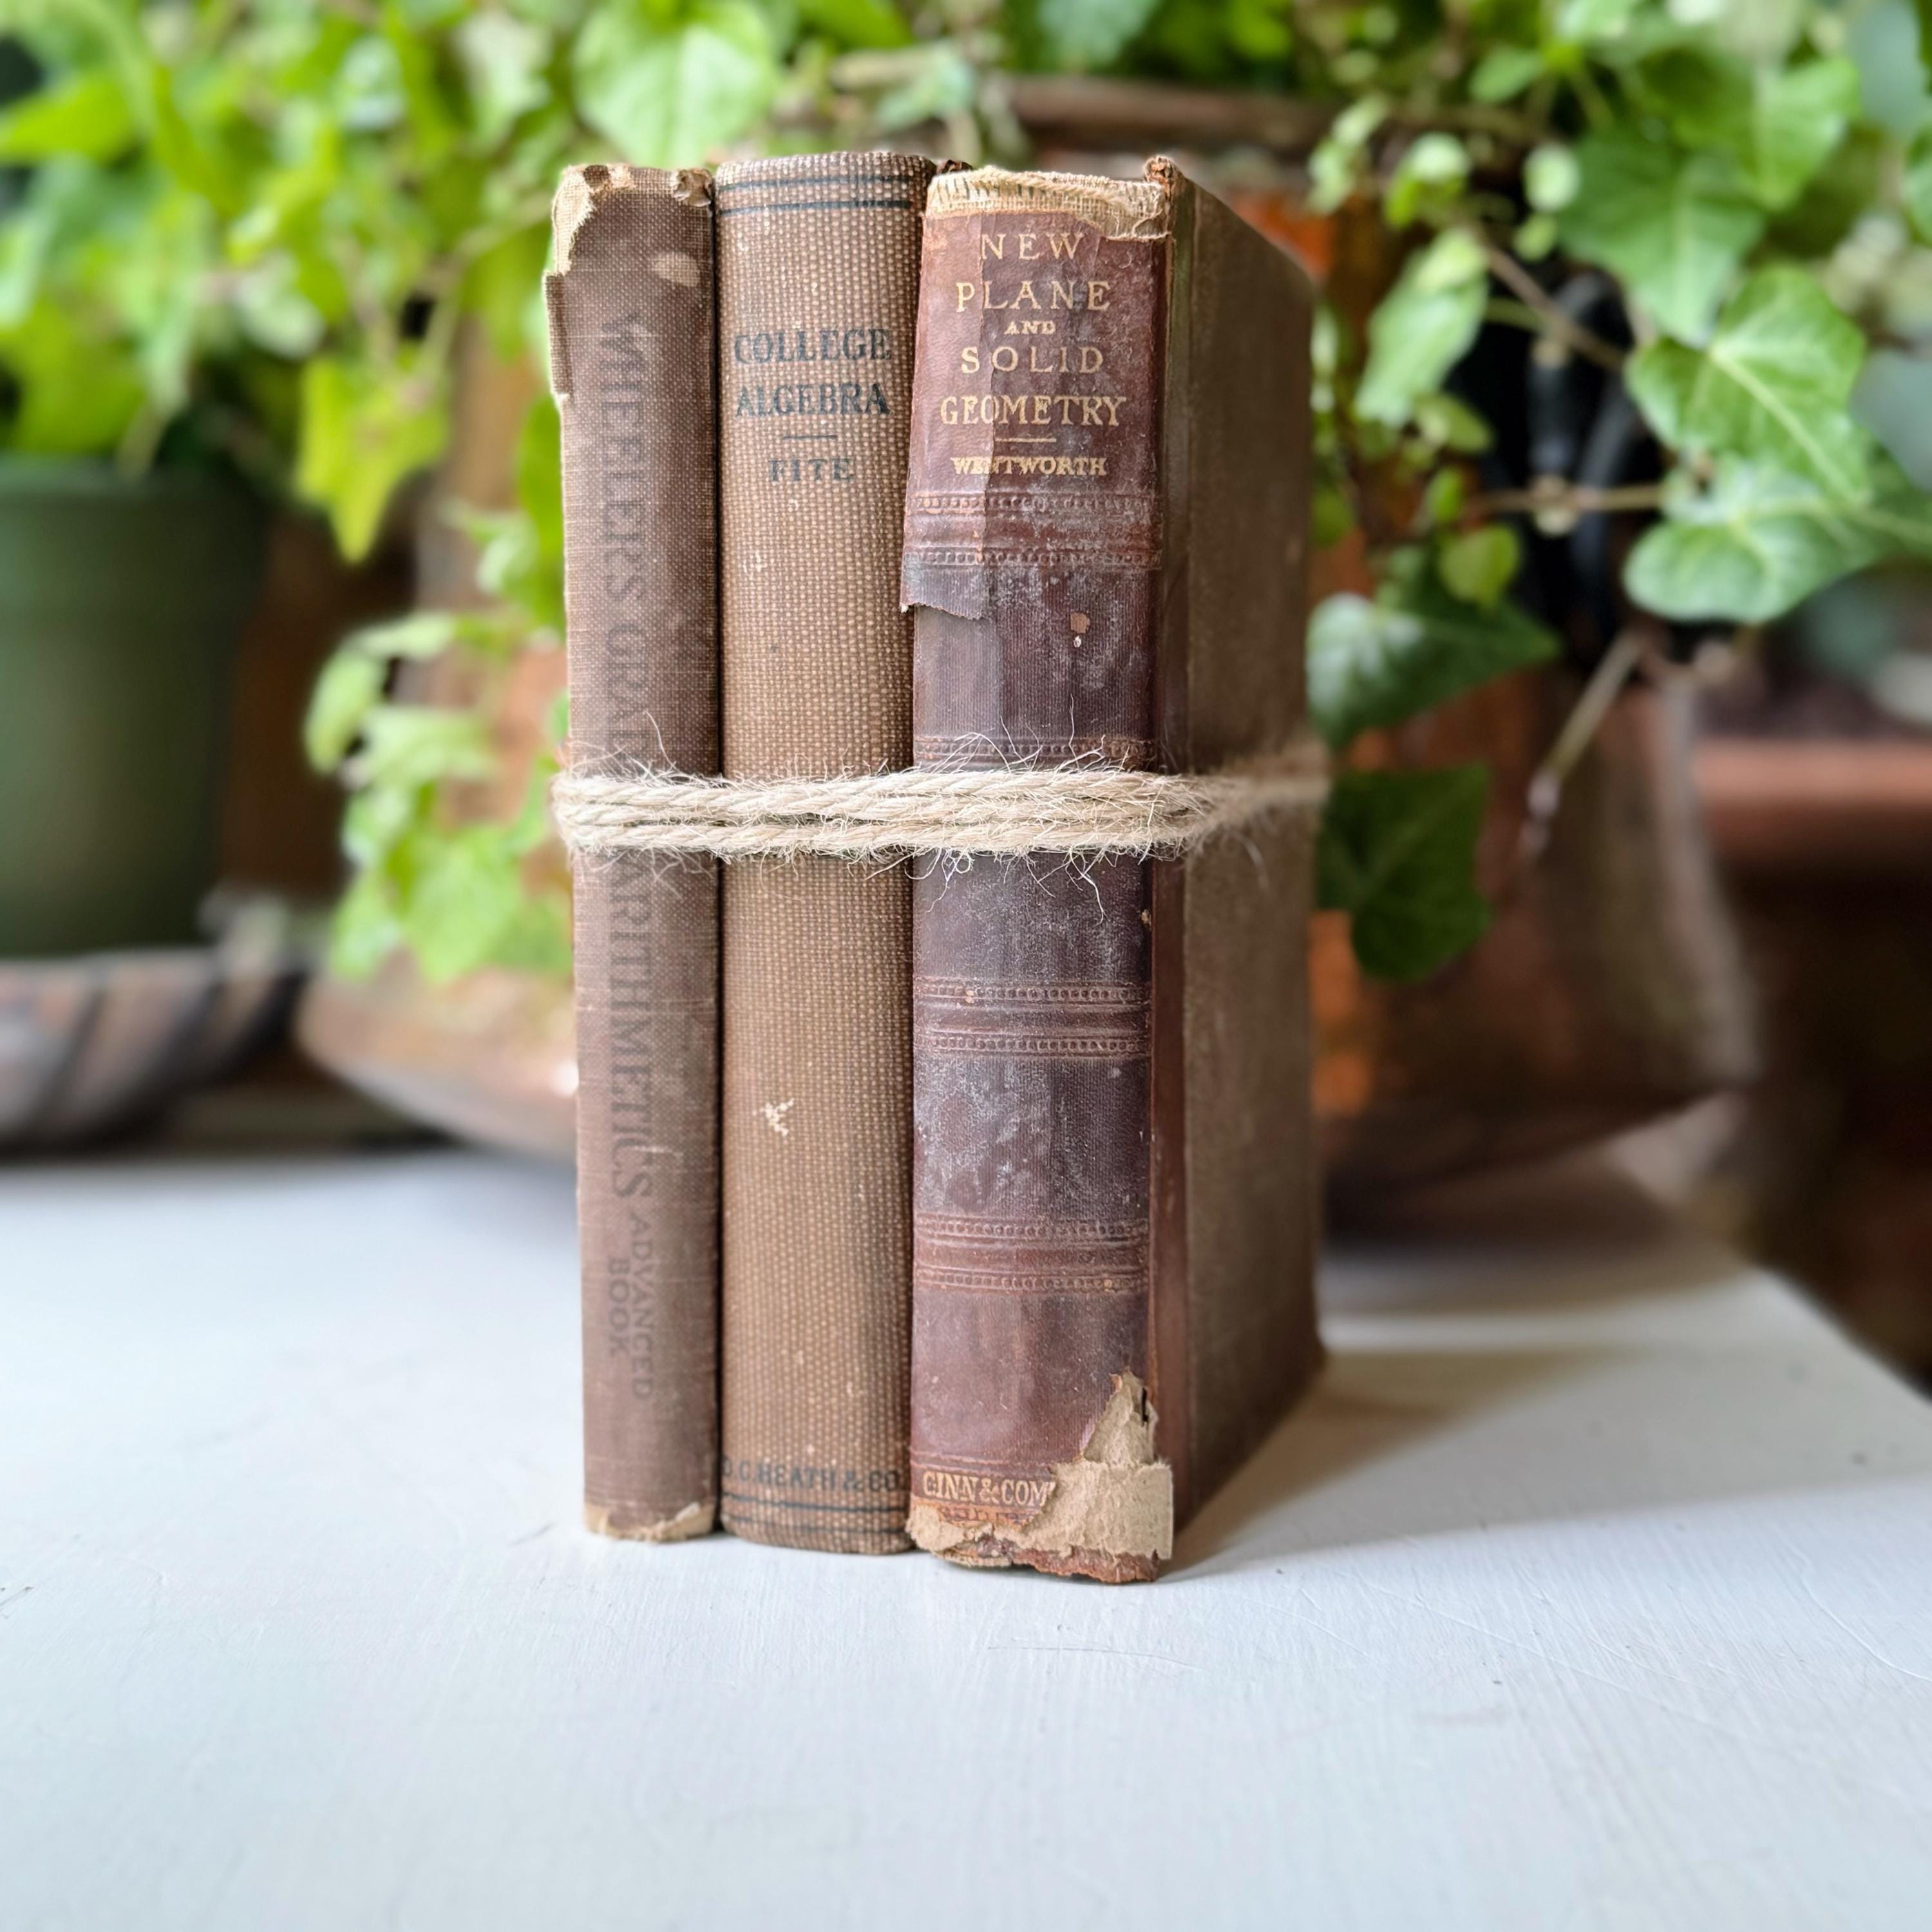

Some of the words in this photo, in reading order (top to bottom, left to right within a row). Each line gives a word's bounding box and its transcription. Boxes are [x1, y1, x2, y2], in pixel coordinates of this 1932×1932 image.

[980, 232, 1085, 260] NEW
[956, 279, 1111, 313] PLANE
[1003, 320, 1056, 336] AND
[734, 328, 891, 364] COLLEGE
[960, 345, 1104, 374] SOLID
[734, 383, 893, 418] ALGEBRA
[940, 394, 1127, 427] GEOMETRY
[768, 458, 855, 483] FITE
[950, 455, 1108, 475] WENTWORTH
[607, 622, 650, 762] GRAD
[609, 857, 652, 1198] ARITHMETICS
[609, 1257, 630, 1358] BOOK
[630, 1212, 654, 1399] ADVANCED
[979, 1477, 999, 1504] &
